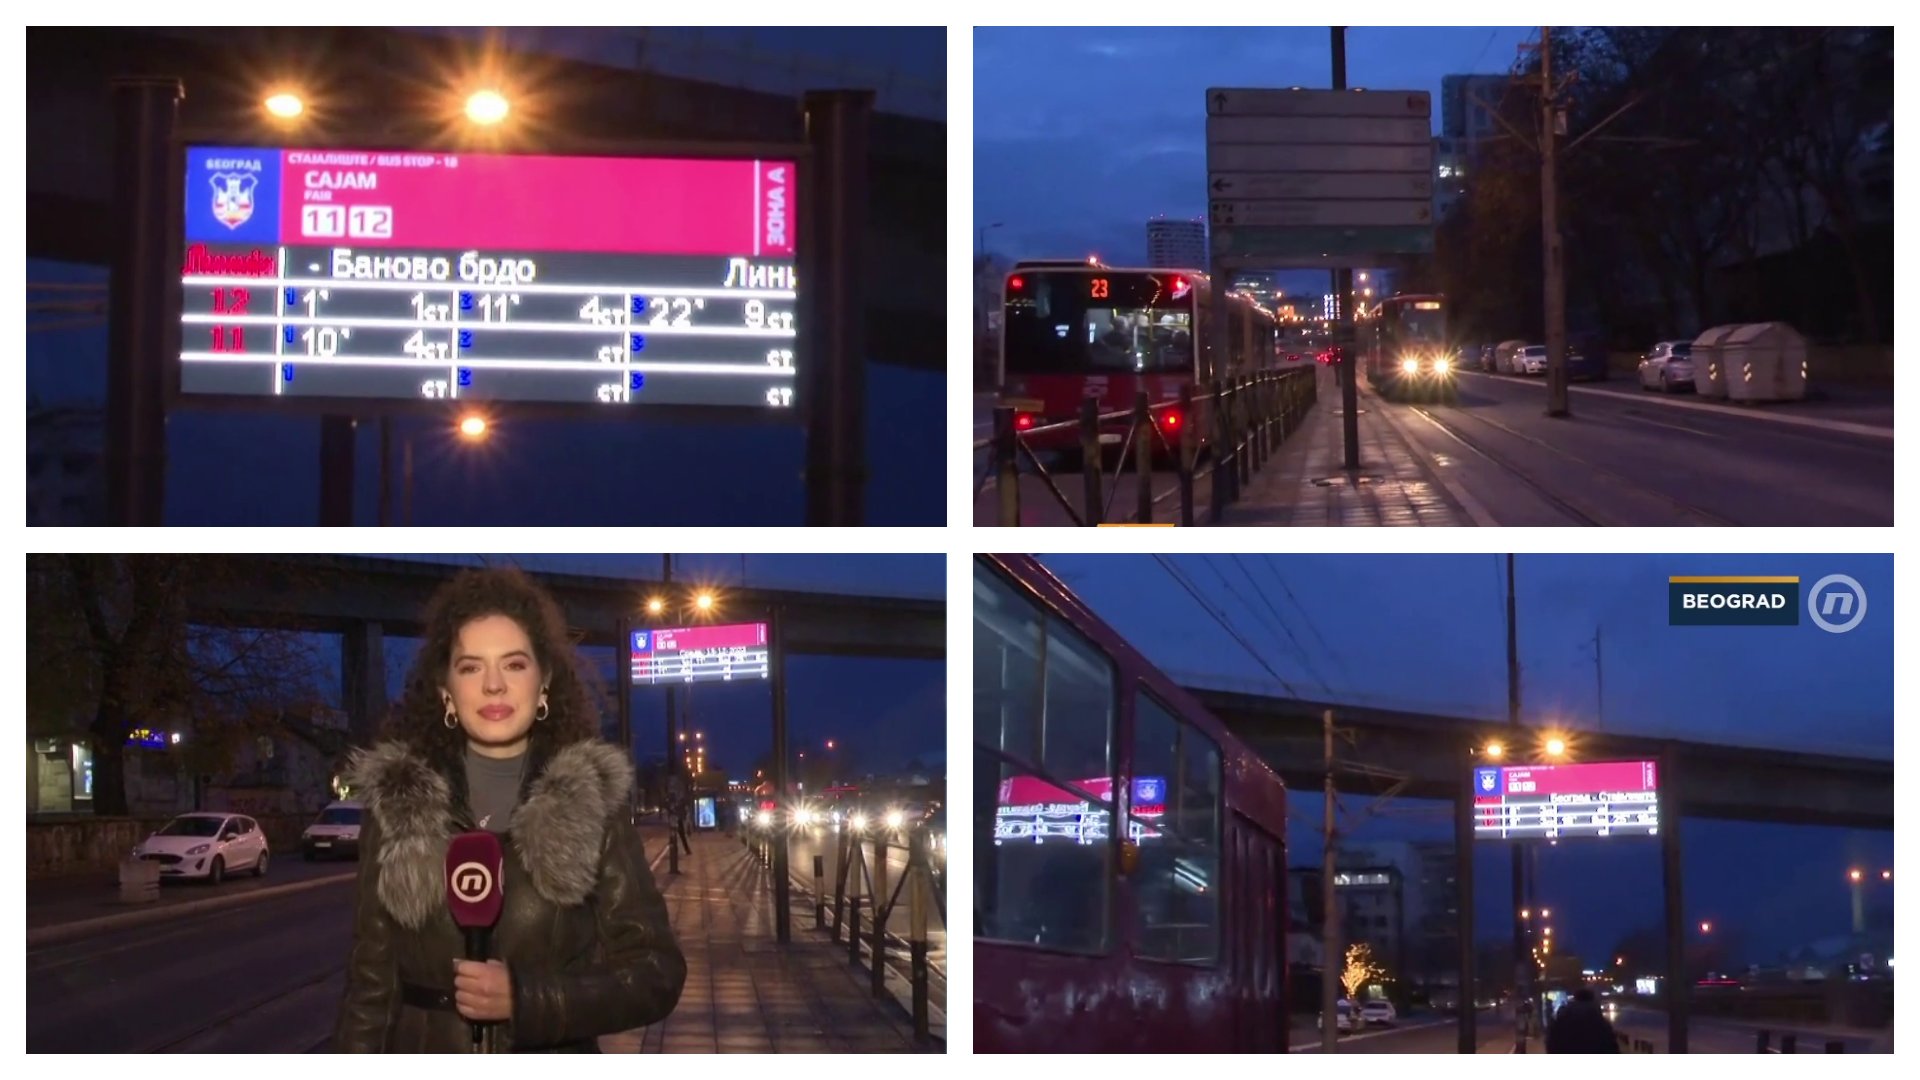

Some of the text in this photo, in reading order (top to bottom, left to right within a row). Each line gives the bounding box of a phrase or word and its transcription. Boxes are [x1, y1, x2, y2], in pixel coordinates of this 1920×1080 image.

[206, 158, 262, 172] БЕОГРАД
[304, 170, 377, 190] САЈАМ
[304, 190, 332, 201] FAIR
[306, 210, 388, 234] 11 12
[332, 248, 450, 281] Баново
[459, 250, 536, 285] брдо
[1091, 279, 1108, 298] 23
